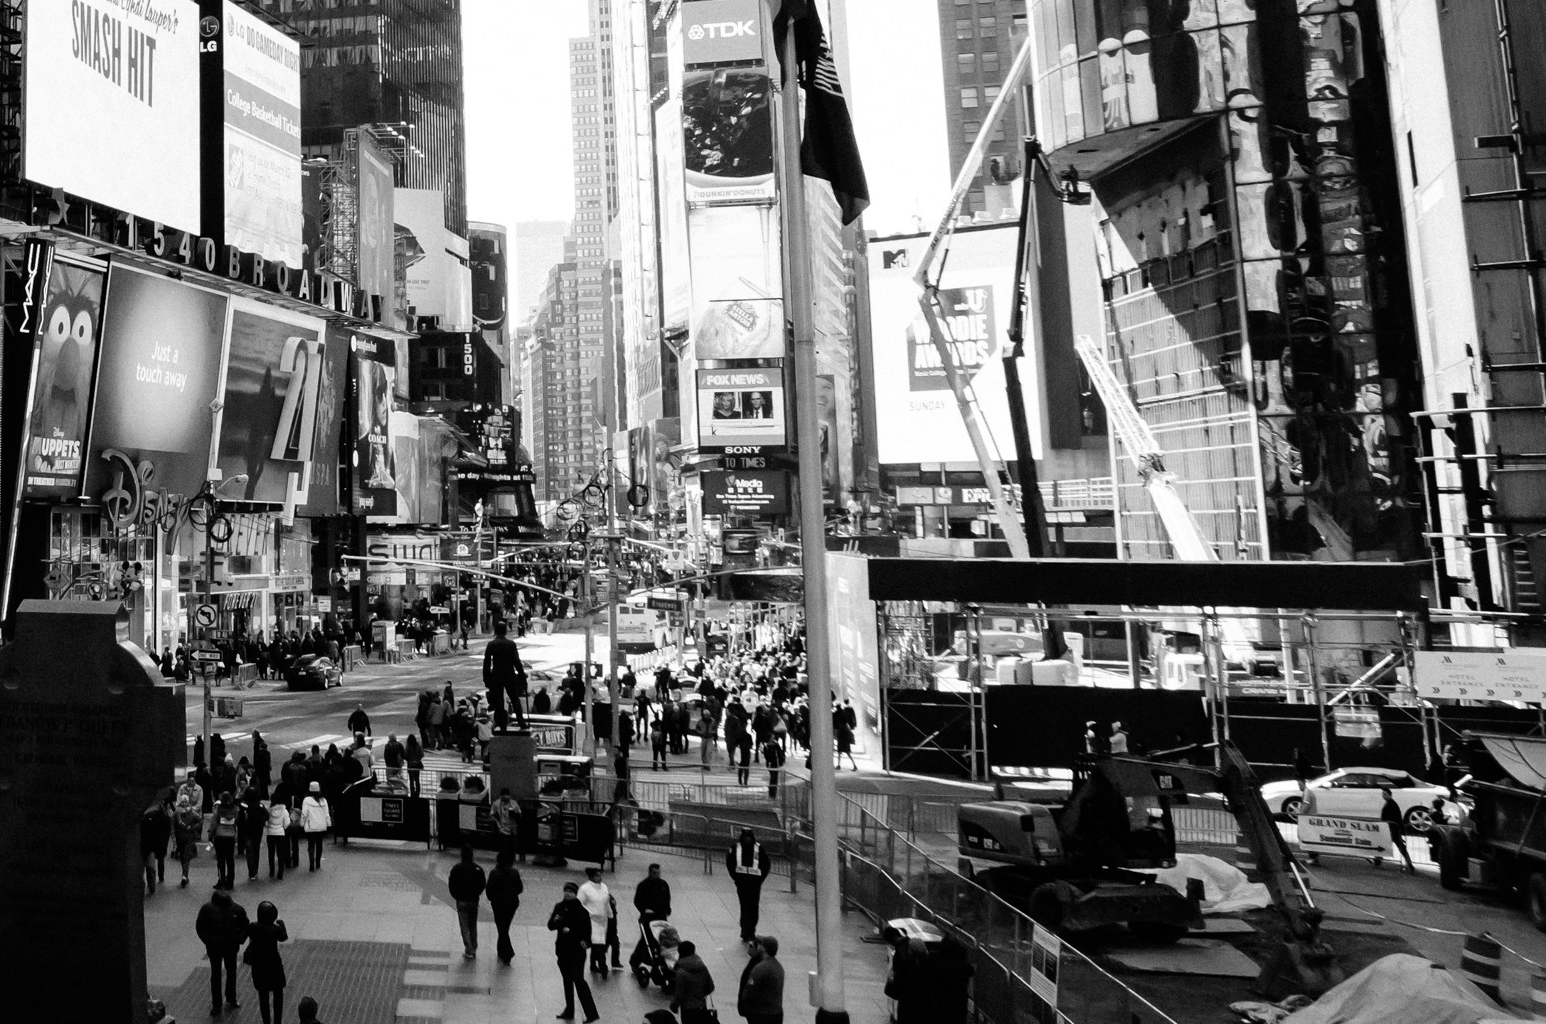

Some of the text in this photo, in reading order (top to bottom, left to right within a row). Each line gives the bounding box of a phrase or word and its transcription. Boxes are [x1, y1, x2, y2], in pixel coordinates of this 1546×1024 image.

[702, 19, 756, 38] TDK
[199, 40, 217, 53] LG
[235, 24, 245, 40] LG
[256, 29, 284, 64] GAMEDAY
[128, 25, 157, 108] HIT
[227, 88, 251, 116] College
[252, 101, 282, 131] Basketball
[151, 340, 178, 364] Just a
[464, 333, 474, 375] 1500
[136, 363, 187, 392] touch away
[707, 374, 764, 385] FOX NEWS
[909, 401, 946, 412] SUNDAY
[32, 436, 81, 458] MUPPETS
[368, 433, 387, 444] COACH
[725, 446, 761, 454] SONY
[726, 457, 766, 468] TO TIMES
[1308, 818, 1380, 833] GRAND SLAM
[1319, 834, 1372, 846] Souvenir Sale
